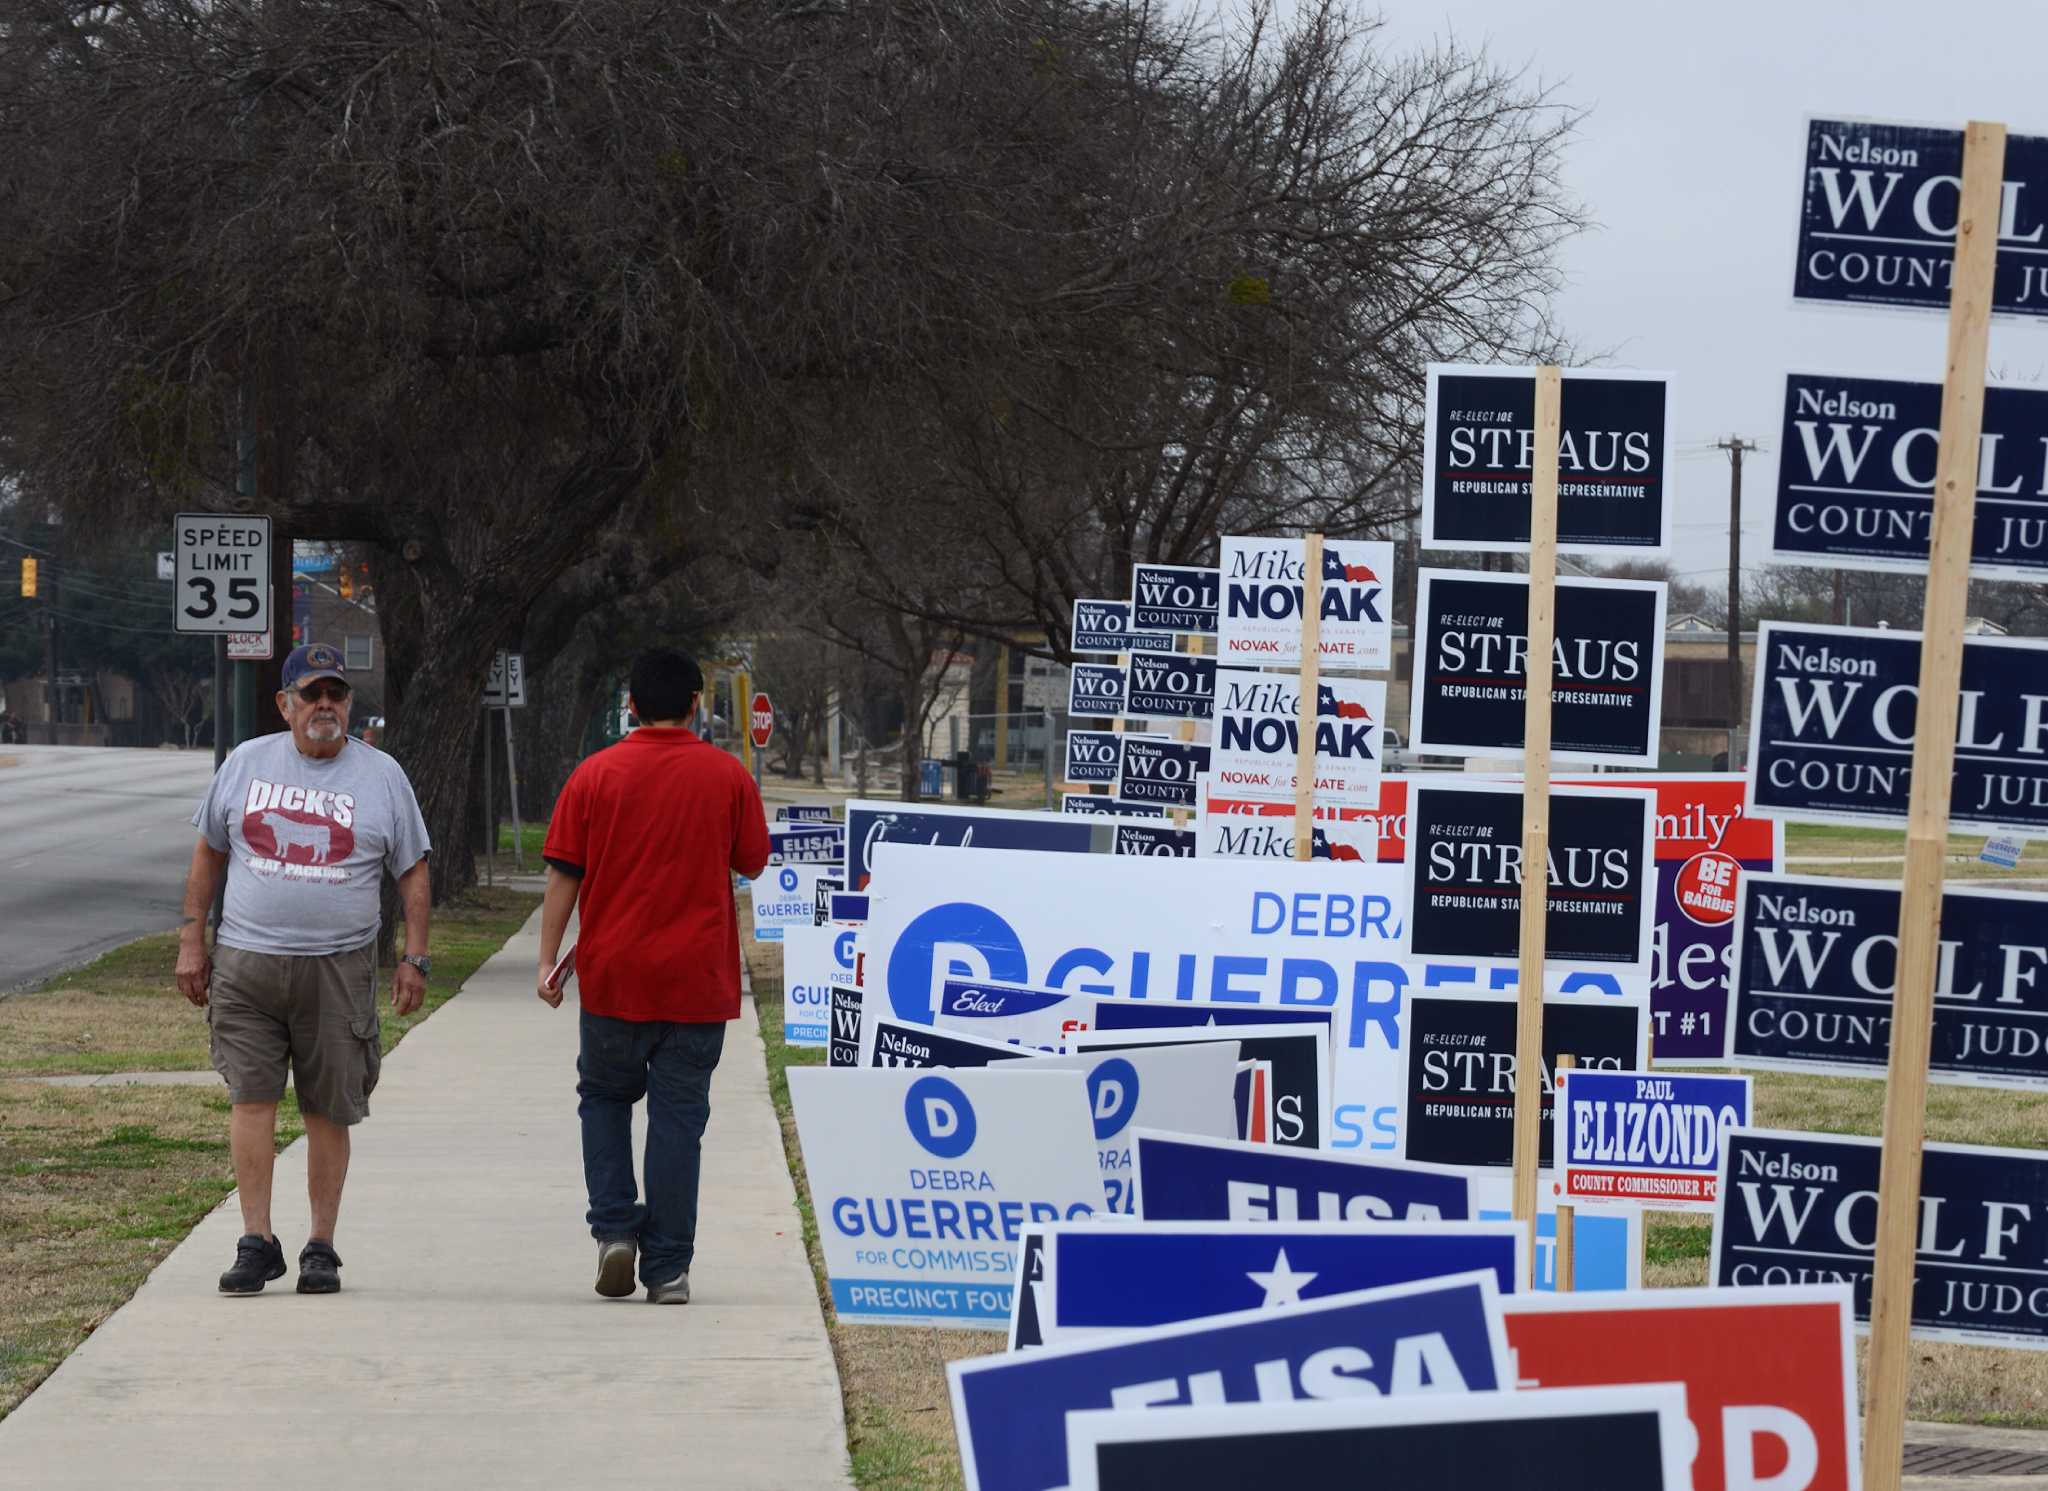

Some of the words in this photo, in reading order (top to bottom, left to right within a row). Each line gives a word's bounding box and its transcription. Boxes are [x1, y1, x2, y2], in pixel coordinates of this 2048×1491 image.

[1819, 135, 1919, 167] Nelson
[1797, 388, 1896, 420] Nelson
[1450, 410, 1494, 422] RE-ELECT
[1496, 411, 1514, 423] JOE
[1452, 481, 1518, 495] REPUBLICAN
[184, 529, 262, 547] SPEED
[192, 553, 252, 571] LIMIT
[1140, 572, 1175, 584] Nelson
[184, 577, 260, 619] 35
[1079, 605, 1106, 615] Nelson
[1137, 612, 1203, 626] COUNTY
[1440, 614, 1485, 627] RE-ELECT
[1487, 616, 1504, 628] JOE
[1076, 635, 1127, 647] COUNTY
[1132, 639, 1170, 649] JUDGE
[1229, 639, 1279, 652] NOVAK
[1135, 657, 1169, 669] Nelson
[1777, 644, 1878, 676] Nelson
[1076, 668, 1103, 679] Nelson
[1131, 696, 1197, 711] COUNTY
[1441, 685, 1507, 700] REPUBLICAN
[1552, 690, 1633, 707] EPRESENTATIVE
[753, 711, 771, 730] STOP
[1072, 735, 1099, 745] Nelson
[1128, 743, 1162, 757] Nelson
[1220, 771, 1270, 786] NOVAK
[1291, 776, 1345, 791] SNATE
[1124, 783, 1189, 799] COUNTY
[245, 778, 355, 829] DICK'S
[1068, 799, 1095, 809] Nelson
[1121, 829, 1156, 842] Nelson
[1429, 824, 1475, 837] RE-ELECT
[1476, 826, 1494, 838] JOE
[782, 836, 834, 852] ELISA
[1213, 826, 1296, 858] Mike
[1697, 857, 1733, 887] BE
[1701, 883, 1722, 897] FOR
[1431, 894, 1498, 910] REPUBLICAN
[1544, 901, 1624, 915] EPRESENTATIVE
[1683, 891, 1735, 915] BARBIE
[1756, 894, 1856, 926] Nelson
[952, 989, 1006, 1014] Elect
[881, 1032, 931, 1058] Nelson
[1423, 1033, 1468, 1046] RE-ELECT
[1470, 1035, 1487, 1047] JOE
[1636, 1080, 1674, 1100] PAUL
[1425, 1104, 1491, 1119] REPUBLICAN
[1739, 1149, 1839, 1182] Nelson
[909, 1168, 996, 1193] DEBRA
[1573, 1174, 1615, 1192] COUNTY
[1617, 1176, 1700, 1196] COMMISSIONER
[1737, 1182, 2048, 1264] WOLF
[856, 1250, 888, 1265] FOR
[892, 1247, 1018, 1273] COMMISSI
[850, 1286, 959, 1313] PRECINCT
